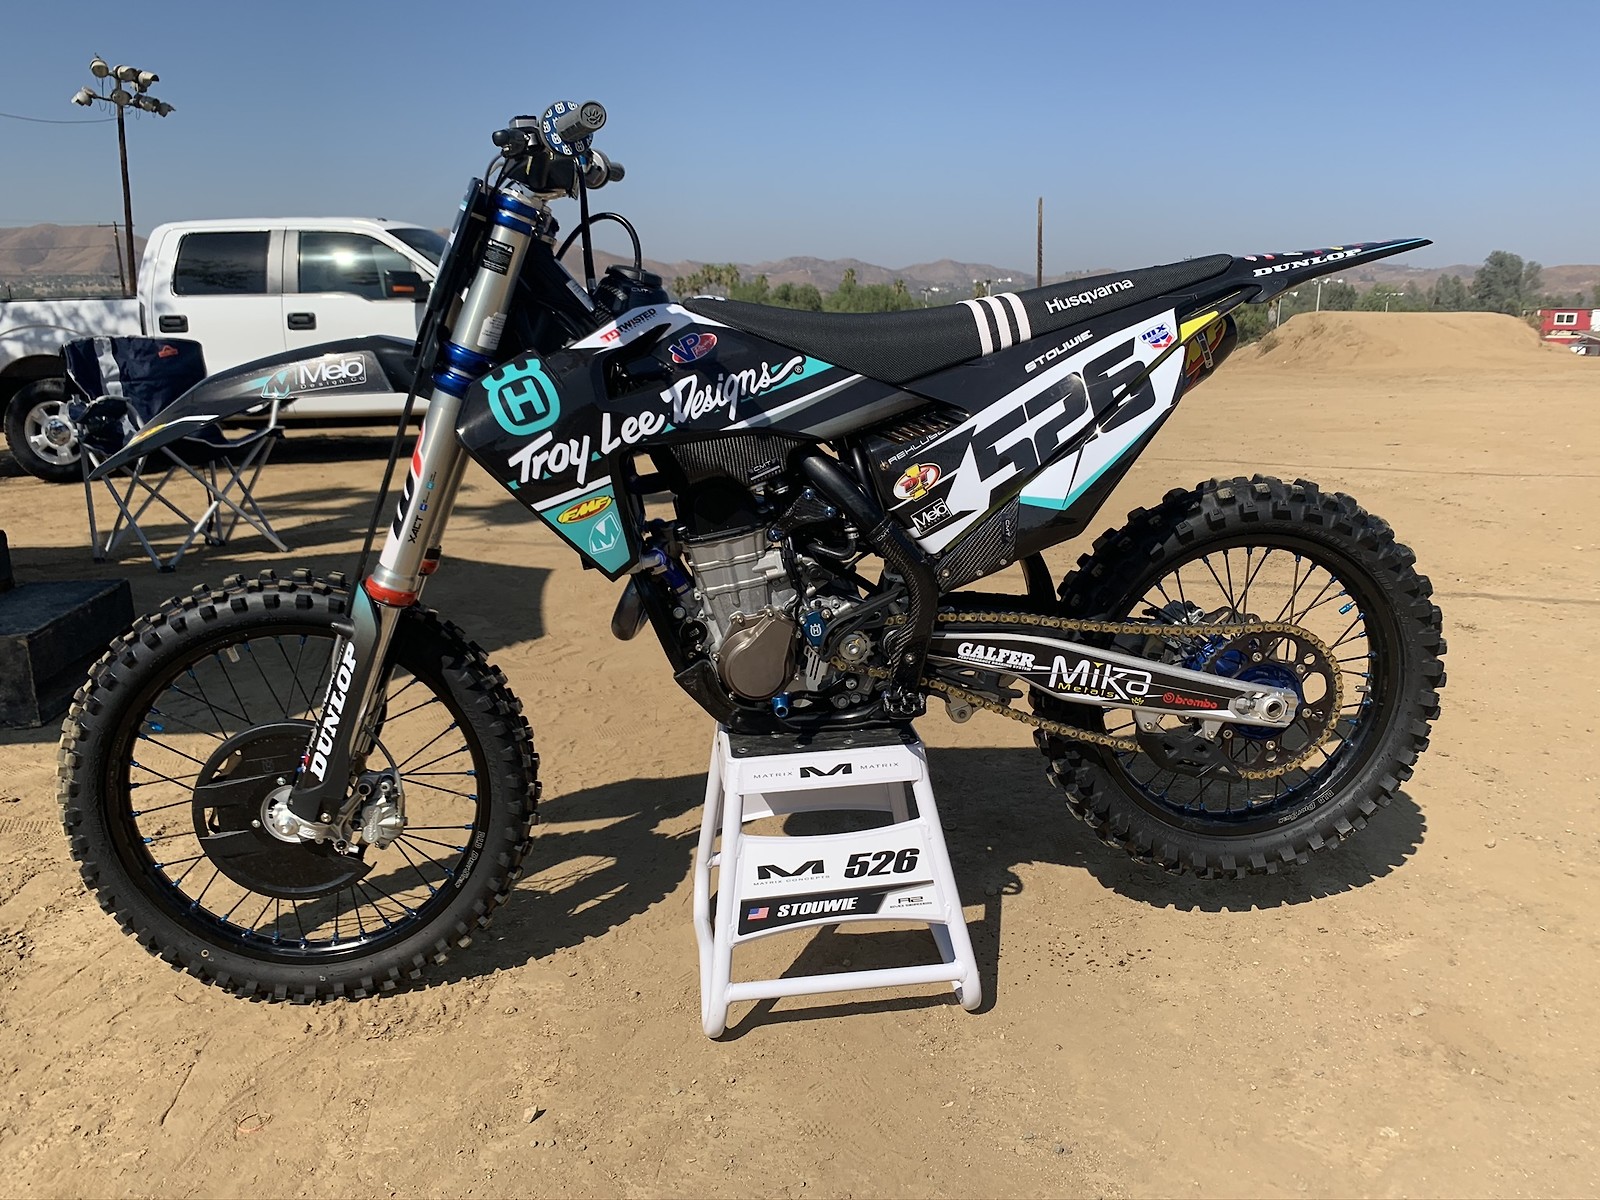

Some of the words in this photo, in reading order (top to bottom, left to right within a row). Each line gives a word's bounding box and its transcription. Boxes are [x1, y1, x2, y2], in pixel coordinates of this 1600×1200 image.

[1252, 249, 1362, 278] DUNLOP
[1045, 279, 1134, 314] Husqvarna
[617, 308, 656, 333] TWISTED
[668, 333, 700, 362] VP
[1024, 329, 1094, 373] STOUWIE
[508, 431, 589, 484] Troy
[601, 411, 667, 455] Lee
[562, 497, 611, 521] FMF
[408, 515, 424, 544] XACT
[957, 642, 1035, 668] GALFER
[1049, 655, 1152, 700] Mika
[1058, 682, 1116, 698] Metals
[310, 641, 357, 782] DUNLOP
[753, 771, 793, 779] MATRIX
[860, 762, 900, 770] MATRIX
[844, 848, 920, 879] 526
[777, 897, 859, 918] STOUWIE
